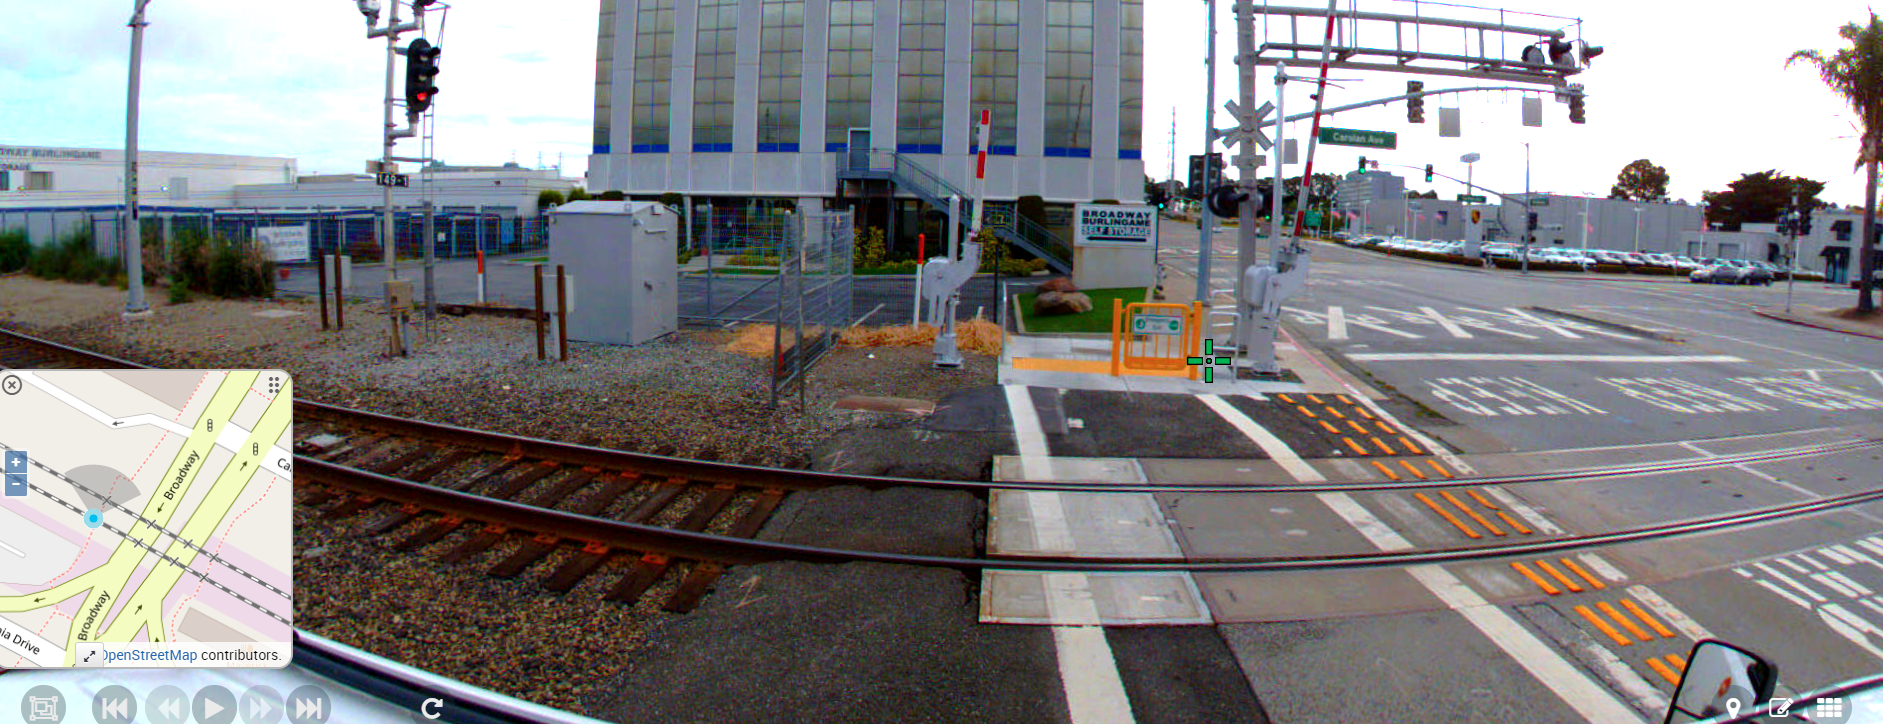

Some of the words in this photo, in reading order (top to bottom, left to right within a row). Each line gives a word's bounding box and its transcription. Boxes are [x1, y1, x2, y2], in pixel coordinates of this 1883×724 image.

[1332, 132, 1366, 143] Carolan
[1368, 134, 1384, 144] Ave
[1083, 210, 1151, 218] BROADWAY
[1082, 217, 1151, 226] BURLINGAME
[1081, 226, 1109, 235] SELF
[1111, 227, 1151, 237] STORAGE
